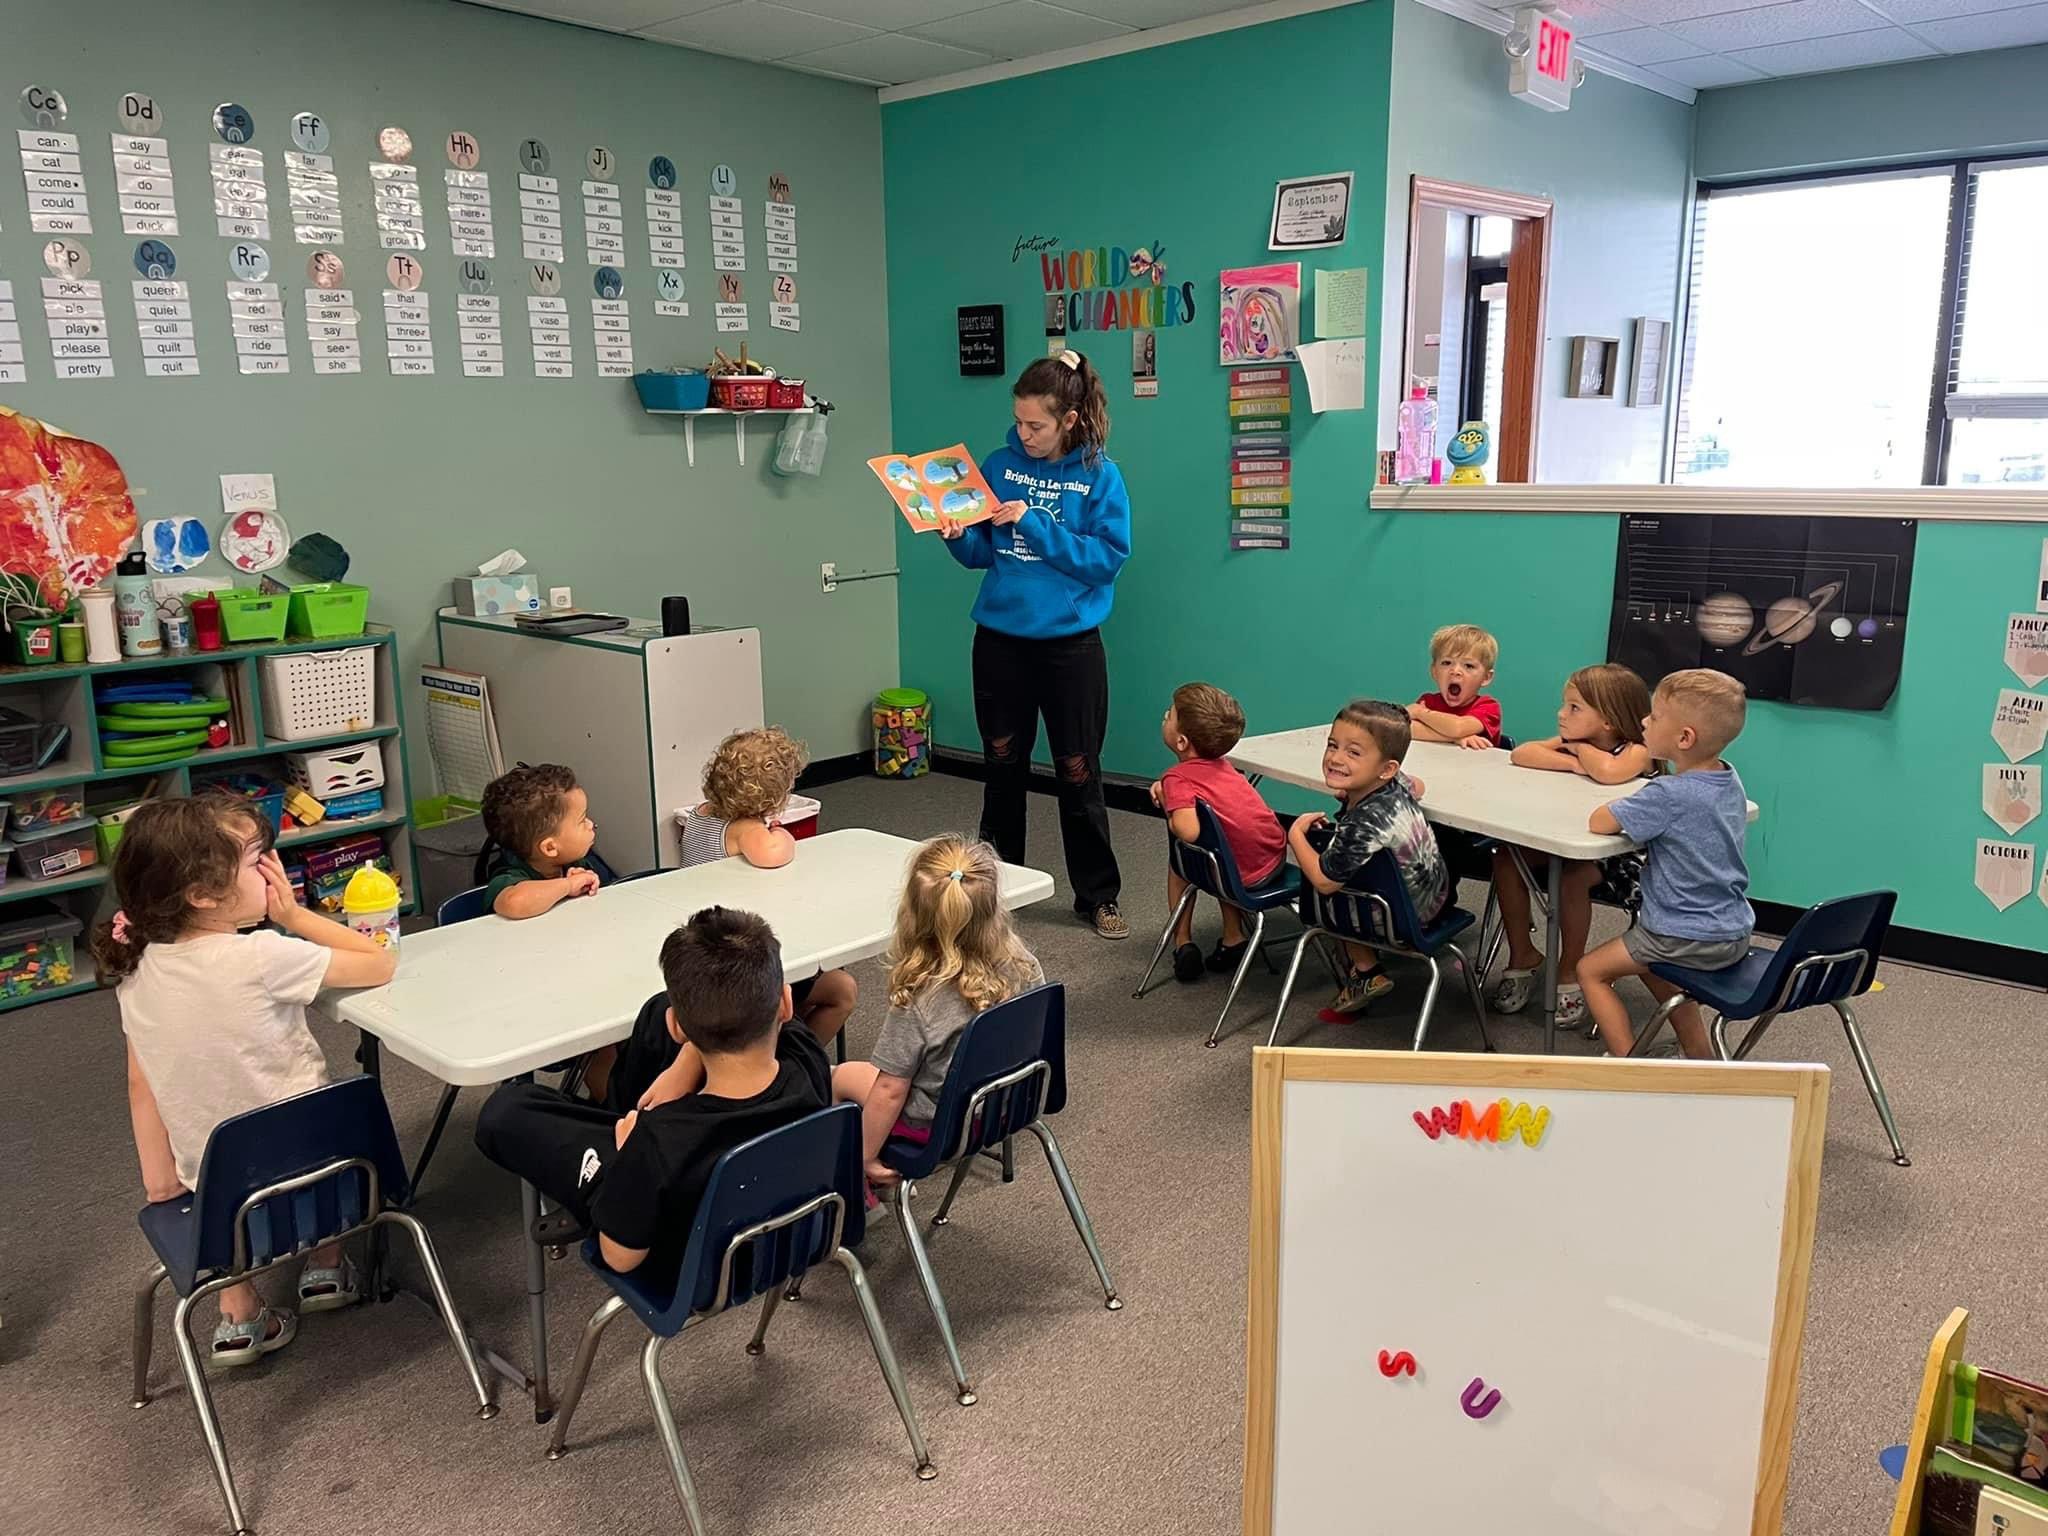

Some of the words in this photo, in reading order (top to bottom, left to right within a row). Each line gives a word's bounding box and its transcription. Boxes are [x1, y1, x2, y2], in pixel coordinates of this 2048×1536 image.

[1537, 20, 1571, 82] EXIT
[28, 87, 58, 109] Cc
[125, 96, 154, 120] Dd
[299, 116, 320, 137] Ff
[37, 137, 60, 147] can
[451, 134, 475, 154] Hh
[130, 141, 151, 154] day
[42, 156, 61, 167] cat
[592, 148, 608, 171] Jj
[134, 159, 152, 171] did
[38, 178, 72, 189] come
[138, 180, 153, 190] do
[769, 175, 790, 193] Mm
[593, 184, 609, 195] jam
[41, 194, 74, 209] could
[459, 191, 479, 202] help
[536, 197, 545, 205] in
[654, 192, 673, 203] keep
[1287, 193, 1339, 209] September
[134, 200, 161, 211] door
[598, 204, 608, 213] jet
[771, 205, 790, 214] make
[460, 208, 480, 218] here
[657, 208, 671, 219] key
[534, 214, 549, 223] into
[774, 219, 785, 227] me
[50, 219, 74, 229] cow
[136, 219, 164, 232] duck
[598, 222, 610, 231] jog
[657, 224, 673, 233] kick
[234, 224, 254, 235] eye
[458, 225, 486, 236] house
[538, 232, 547, 240] is
[774, 233, 789, 241] mud
[595, 237, 615, 248] jump
[661, 239, 672, 249] kid
[465, 243, 482, 253] hurt
[539, 248, 546, 257] it
[774, 246, 790, 255] must
[1011, 234, 1060, 263] future
[51, 240, 81, 268] Pp
[140, 242, 174, 268] Qq
[237, 246, 260, 267] Rr
[599, 254, 613, 264] just
[313, 253, 337, 274] Ss
[658, 256, 678, 265] know
[722, 259, 738, 268] look
[394, 256, 413, 276] Tt
[464, 261, 486, 281] Uu
[777, 262, 788, 271] my
[1041, 246, 1130, 291] WORLD
[535, 265, 554, 283] Vv
[662, 271, 679, 290] Xx
[722, 274, 738, 293] Yy
[777, 276, 792, 293] Zz
[59, 283, 84, 295] pick
[244, 287, 262, 296] ran
[319, 293, 341, 303] said
[396, 294, 415, 304] that
[466, 298, 491, 308] uncle
[248, 304, 266, 314] red
[539, 301, 556, 309] van
[601, 303, 620, 312] want
[663, 304, 681, 315] x-ray
[777, 306, 792, 314] zero
[1068, 281, 1196, 332] CHANGERS
[149, 306, 178, 318] quiet
[320, 310, 341, 319] saw
[399, 311, 416, 320] the
[466, 314, 492, 323] under
[538, 317, 560, 326] vase
[778, 319, 792, 327] zoo
[248, 323, 269, 334] rest
[603, 320, 620, 328] was
[726, 320, 739, 329] you
[65, 323, 90, 336] play
[154, 324, 178, 335] quill
[323, 327, 342, 337] say
[396, 327, 420, 337] three
[475, 332, 487, 342] up
[542, 333, 560, 343] very
[606, 335, 619, 343] we
[60, 340, 101, 356] please
[157, 342, 181, 354] quilt
[251, 341, 272, 351] ride
[326, 344, 345, 353] see
[404, 344, 416, 352] to
[476, 350, 488, 358] us
[543, 349, 562, 359] vest
[606, 350, 622, 358] well
[67, 363, 102, 376] pretty
[161, 362, 183, 373] quit
[256, 361, 273, 369] run
[328, 360, 347, 369] she
[403, 363, 421, 371] two
[475, 365, 492, 374] use
[544, 366, 563, 375] vine
[603, 365, 628, 375] where
[1028, 487, 1061, 500] Cnter
[2012, 696, 2044, 712] APRIL
[2000, 769, 2027, 781] JULY
[1983, 844, 2030, 860] OCTOBER
[334, 850, 359, 868] play
